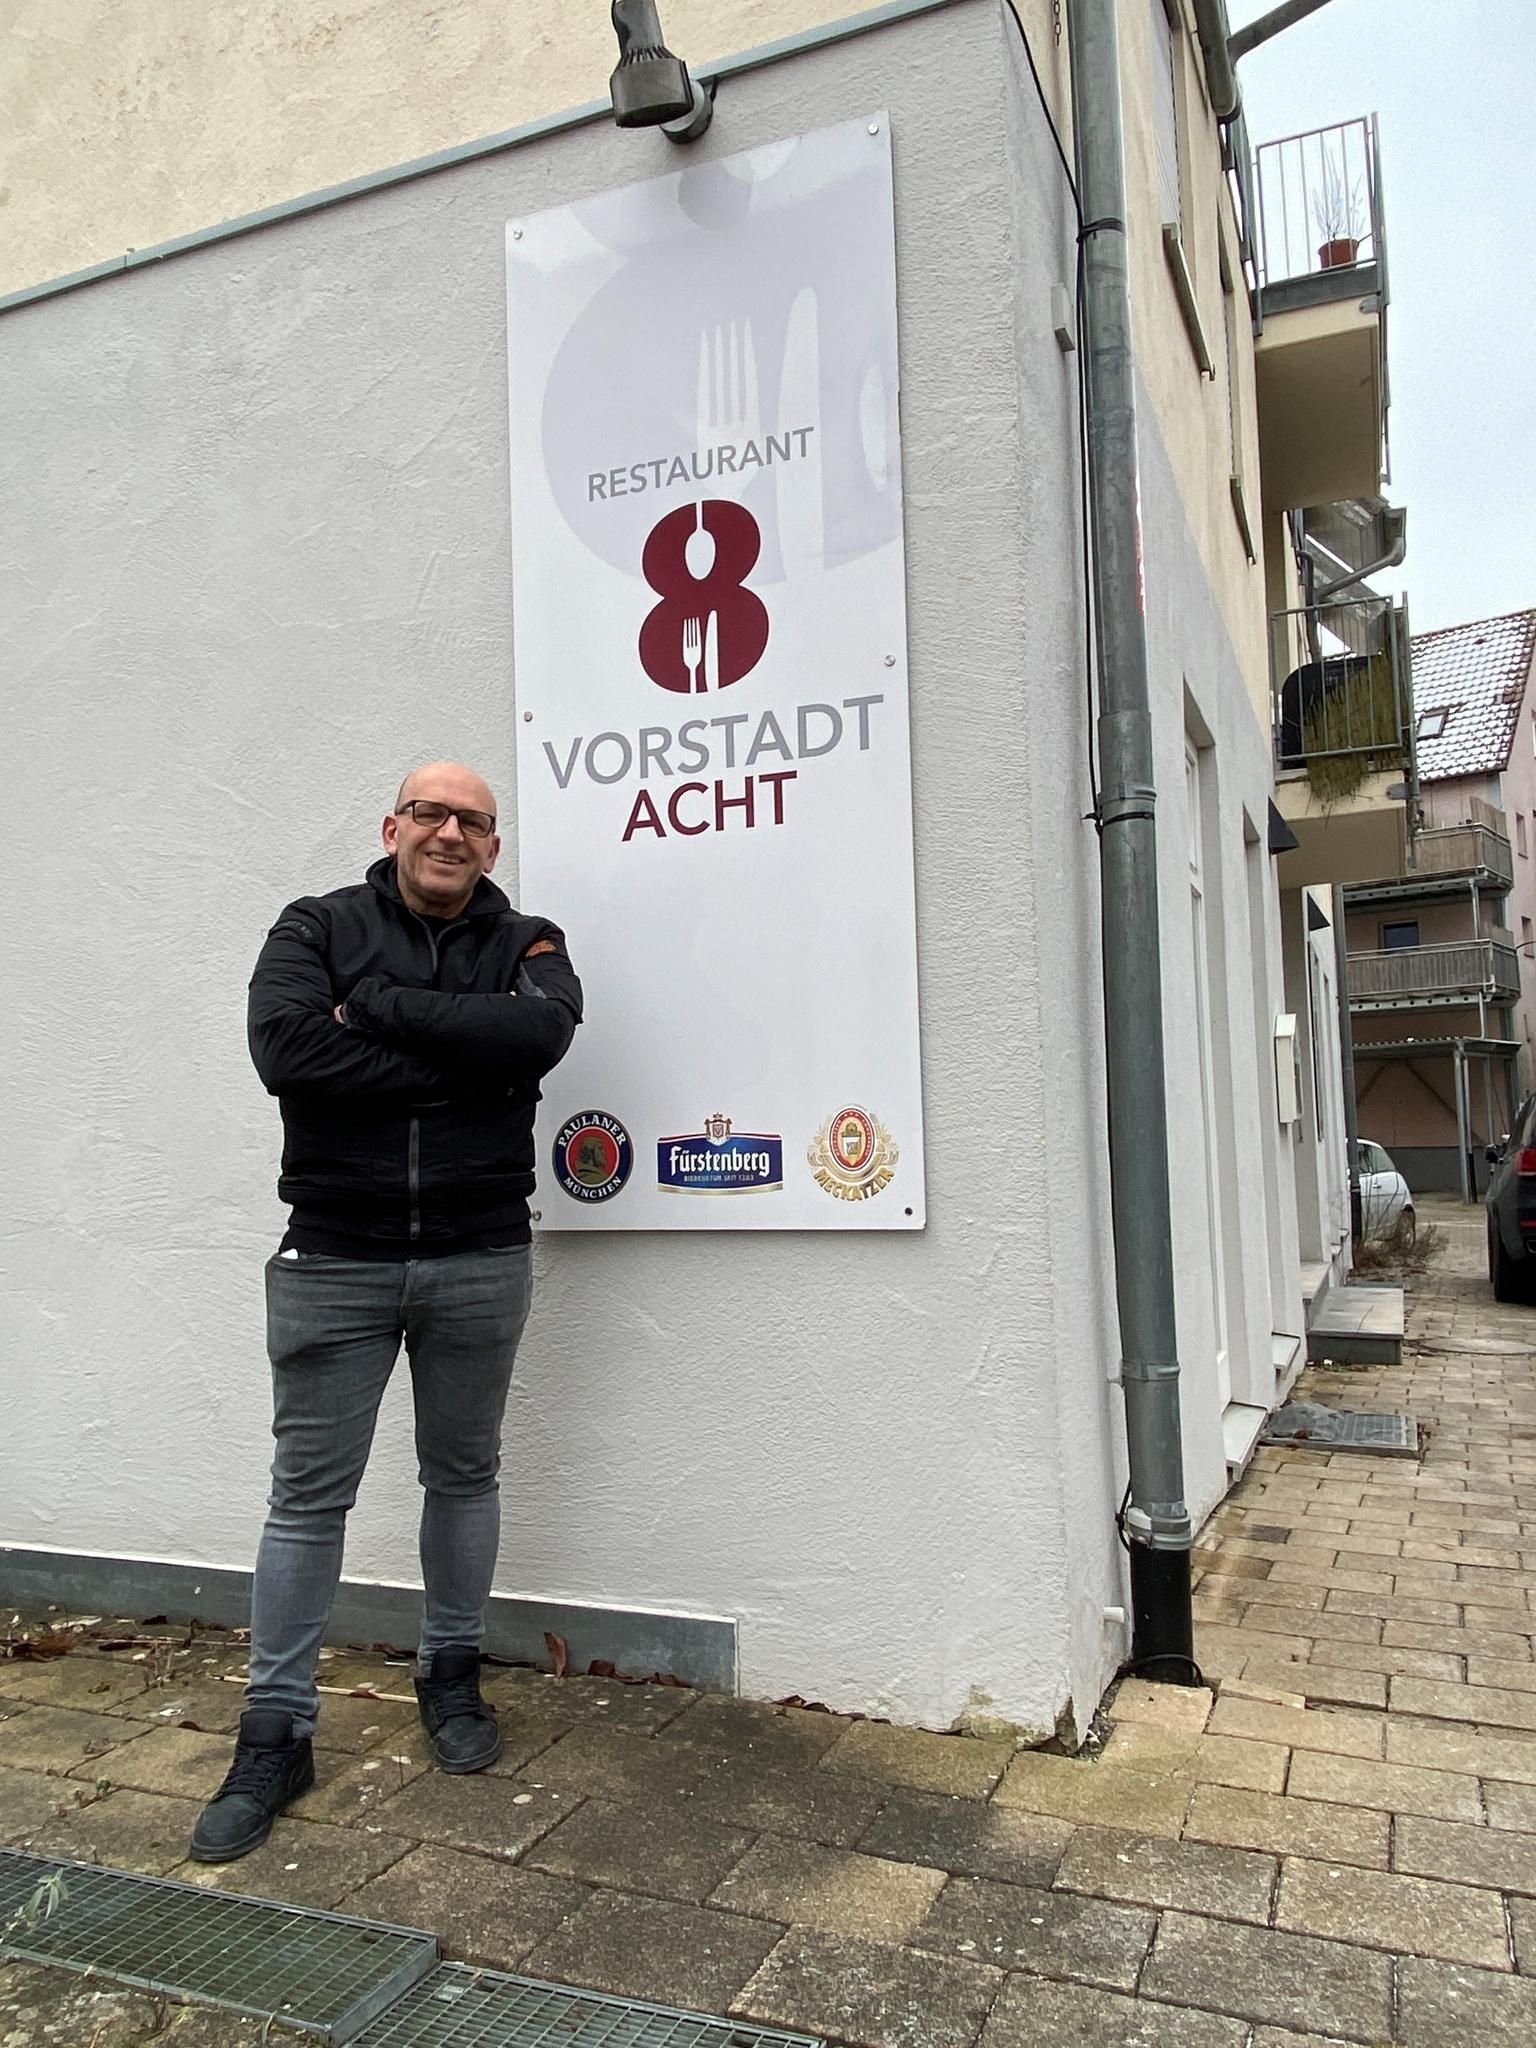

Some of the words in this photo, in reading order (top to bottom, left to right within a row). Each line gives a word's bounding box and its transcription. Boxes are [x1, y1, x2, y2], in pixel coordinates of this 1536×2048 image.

[588, 426, 814, 501] RESTAURANT
[638, 499, 769, 694] 8
[542, 694, 884, 789] VORSTADT
[621, 770, 798, 841] ACHT
[558, 1114, 626, 1148] PAULANER
[669, 1145, 770, 1178] Fürstenberg
[813, 1167, 895, 1201] MECKATZER
